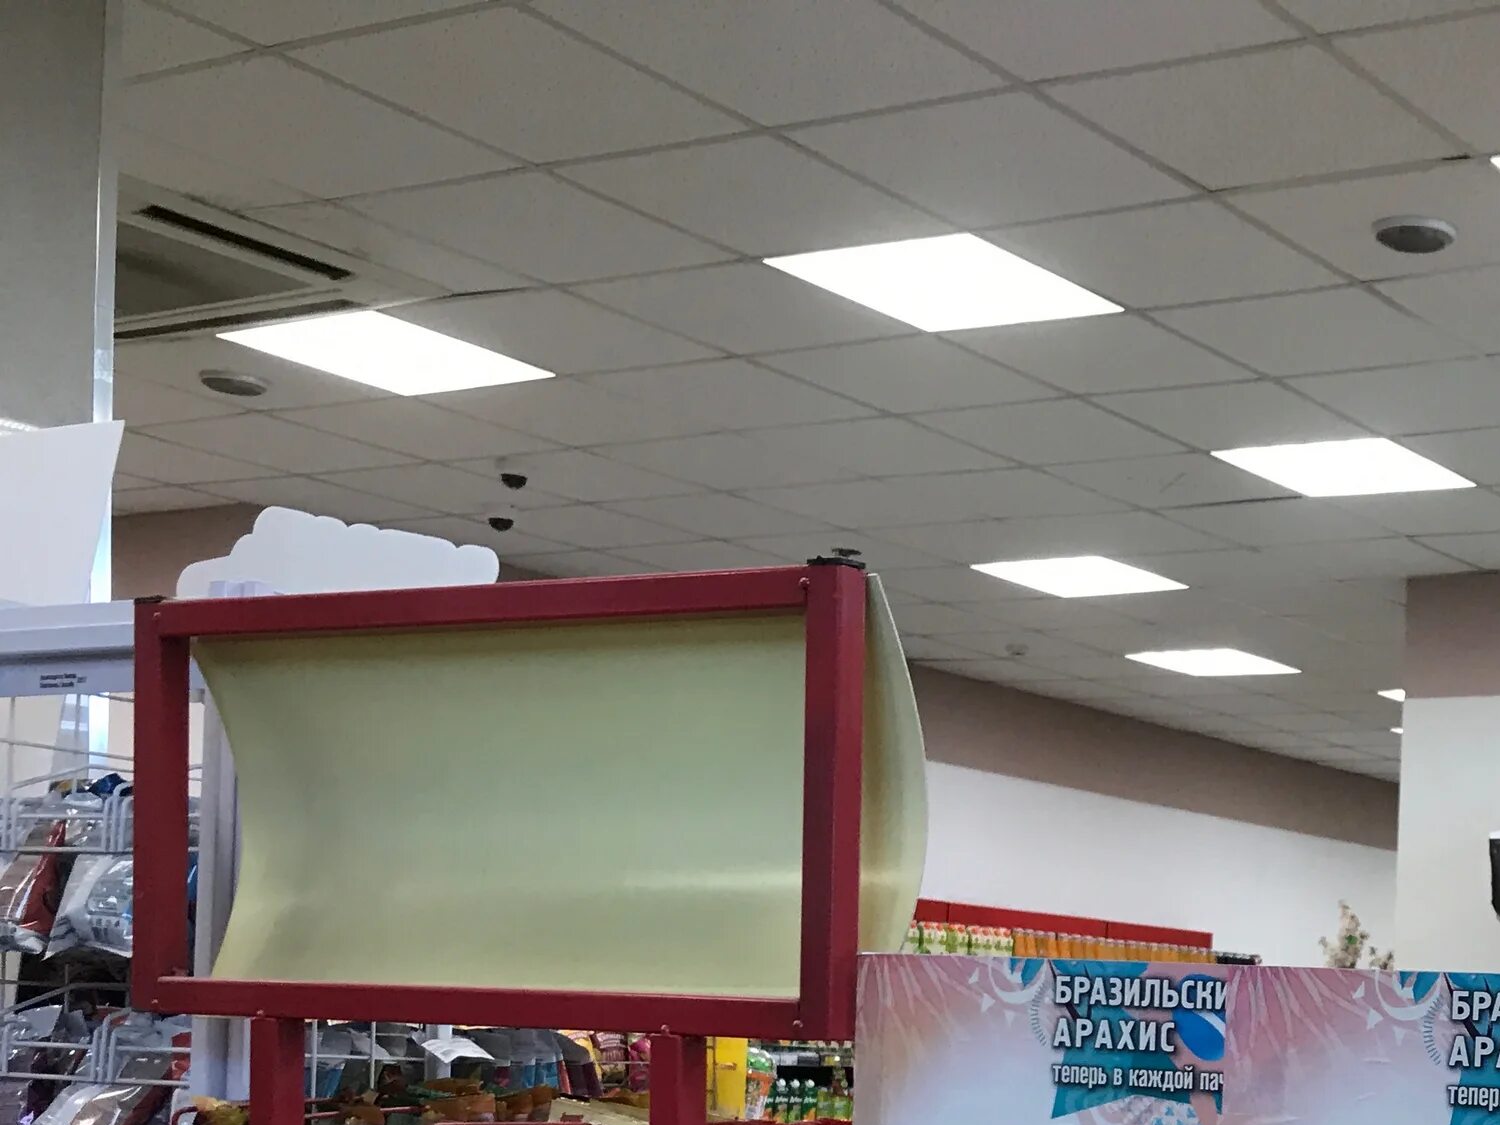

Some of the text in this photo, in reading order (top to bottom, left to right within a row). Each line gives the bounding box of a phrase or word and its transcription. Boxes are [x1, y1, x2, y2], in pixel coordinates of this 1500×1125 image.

[1055, 975, 1228, 1010] БРАЗИЛЬСКИ
[1053, 1018, 1176, 1053] АРАХИС
[1052, 1065, 1107, 1089] теперь
[1113, 1069, 1123, 1086] в
[1129, 1066, 1193, 1092] каждой
